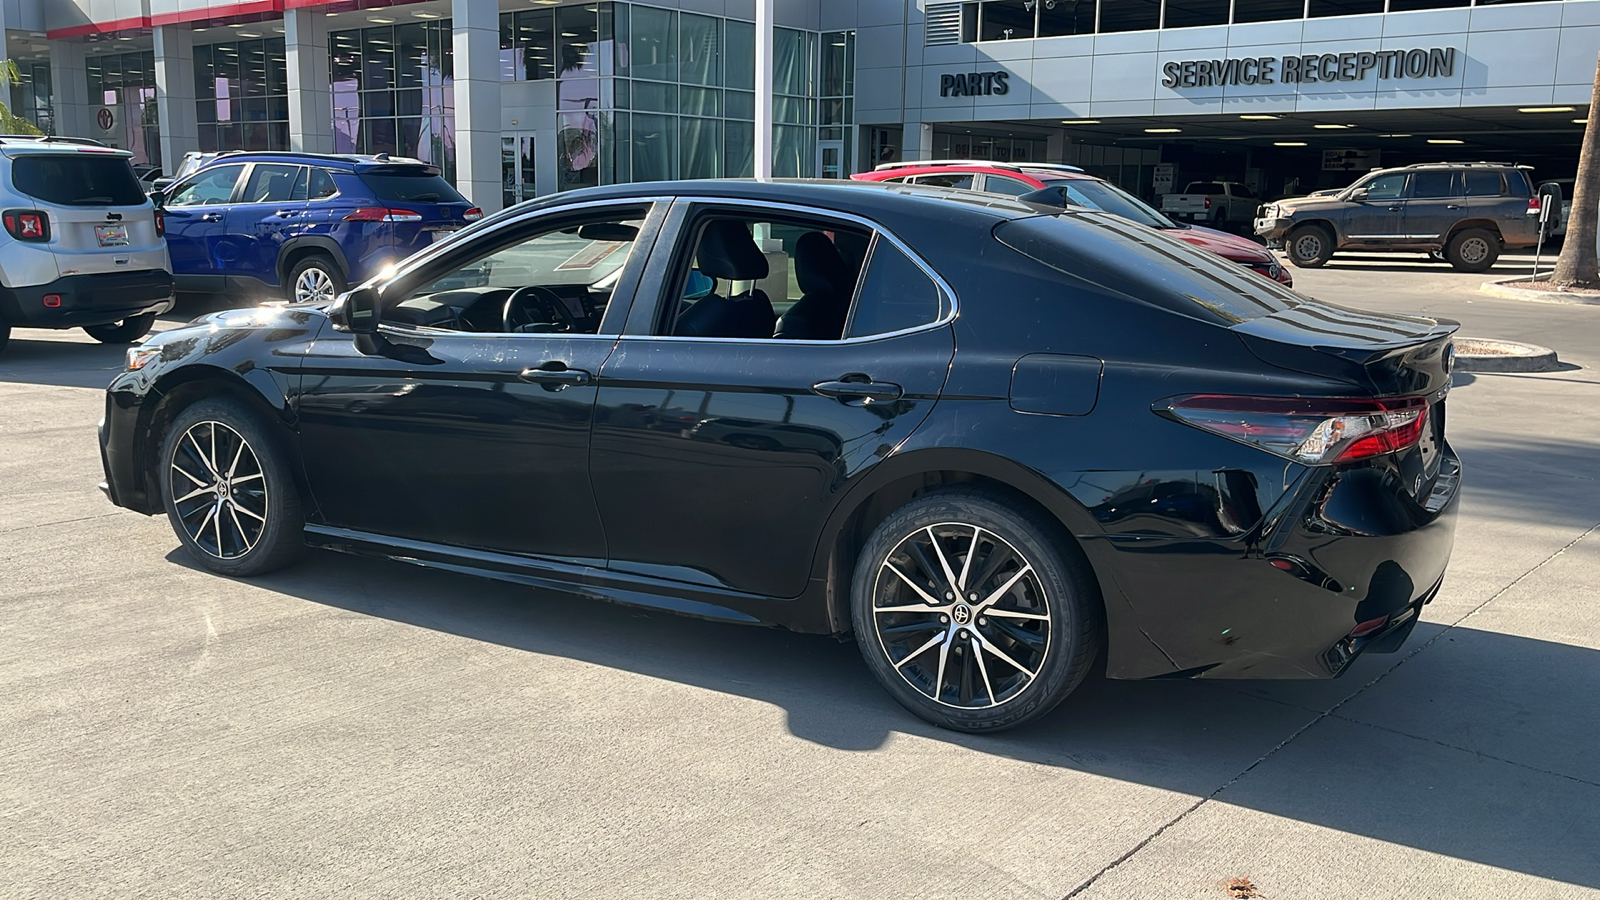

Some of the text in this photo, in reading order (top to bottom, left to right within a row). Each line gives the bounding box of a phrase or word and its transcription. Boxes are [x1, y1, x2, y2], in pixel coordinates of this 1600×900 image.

[940, 71, 1009, 97] PARTS
[1162, 47, 1457, 88] SERVICE RECEPTION
